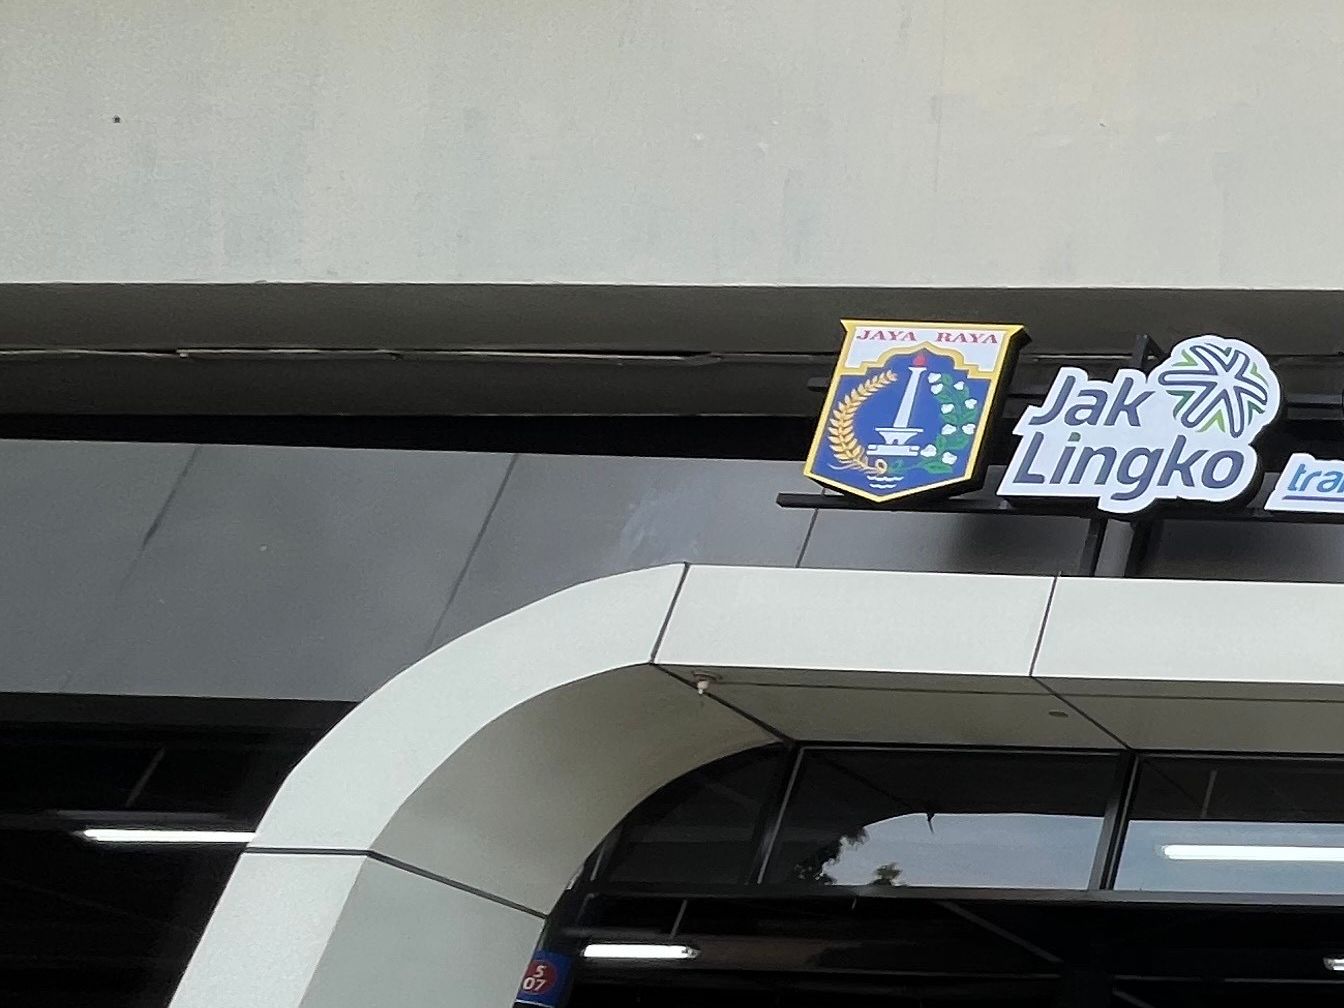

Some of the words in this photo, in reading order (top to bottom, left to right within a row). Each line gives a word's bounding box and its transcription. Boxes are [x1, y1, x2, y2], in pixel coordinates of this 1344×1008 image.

[856, 329, 917, 342] JAYA
[935, 331, 998, 344] RAYA
[1028, 375, 1156, 427] Jak
[1012, 431, 1245, 501] Lingko
[523, 976, 547, 991] 07
